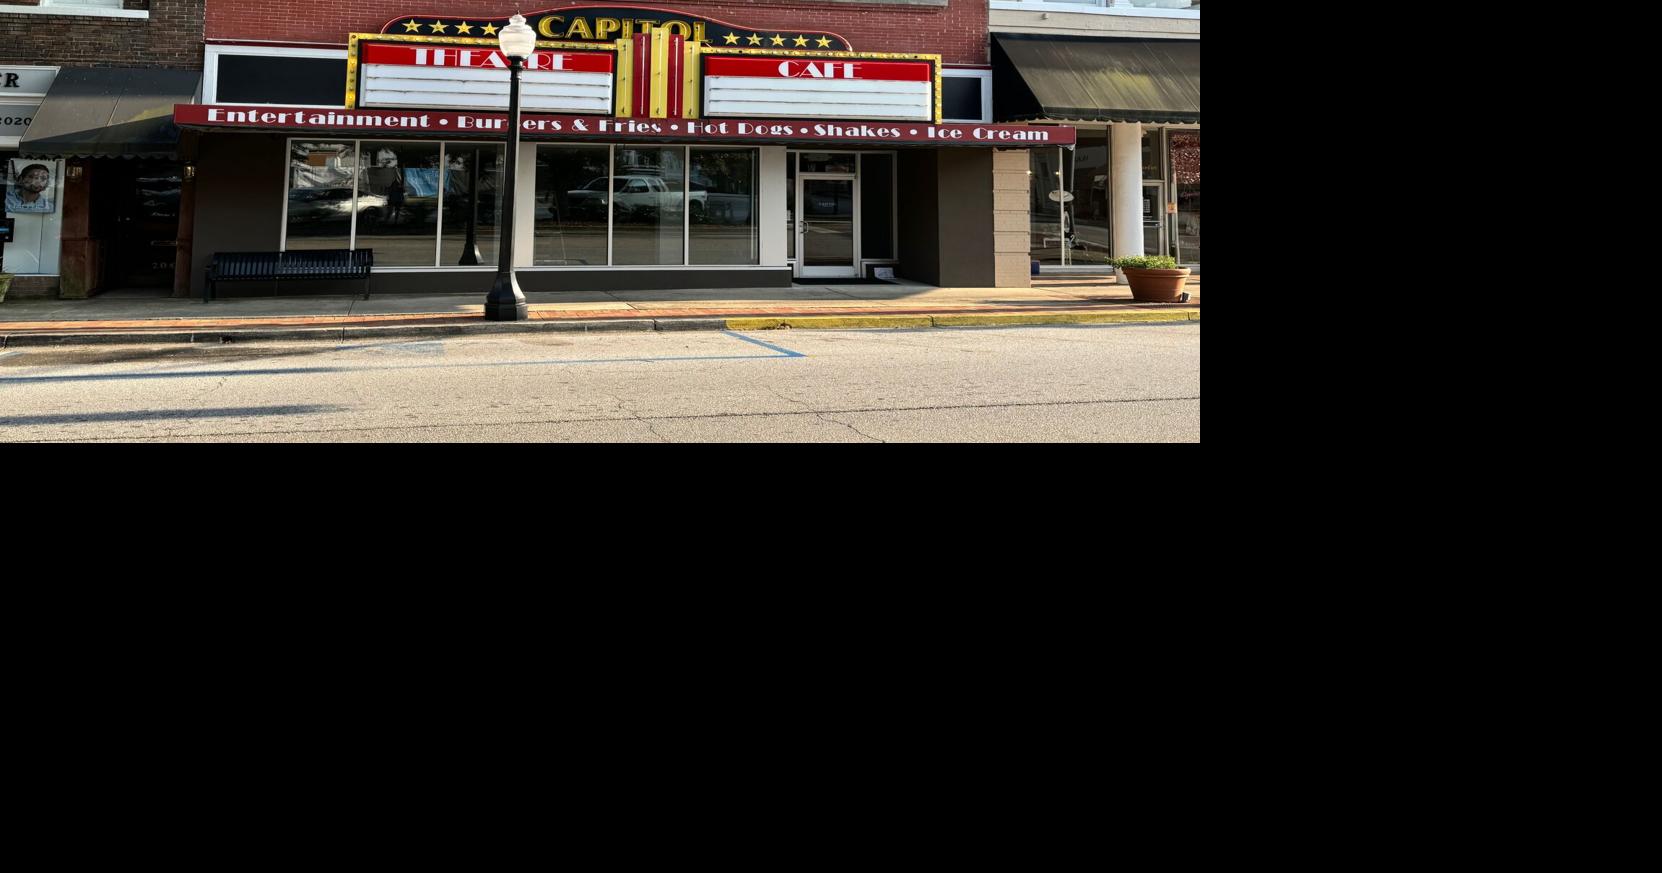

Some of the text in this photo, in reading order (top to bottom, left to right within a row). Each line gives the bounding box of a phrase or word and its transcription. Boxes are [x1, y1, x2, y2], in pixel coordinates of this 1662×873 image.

[538, 15, 713, 43] CAPITOL
[411, 48, 573, 70] THEARE
[0, 72, 20, 88] R
[778, 61, 863, 79] CAFE
[0, 116, 32, 126] 020
[207, 108, 1049, 141] Entertainment Burers & Fries Hot Dogs Shakes Ice Cream
